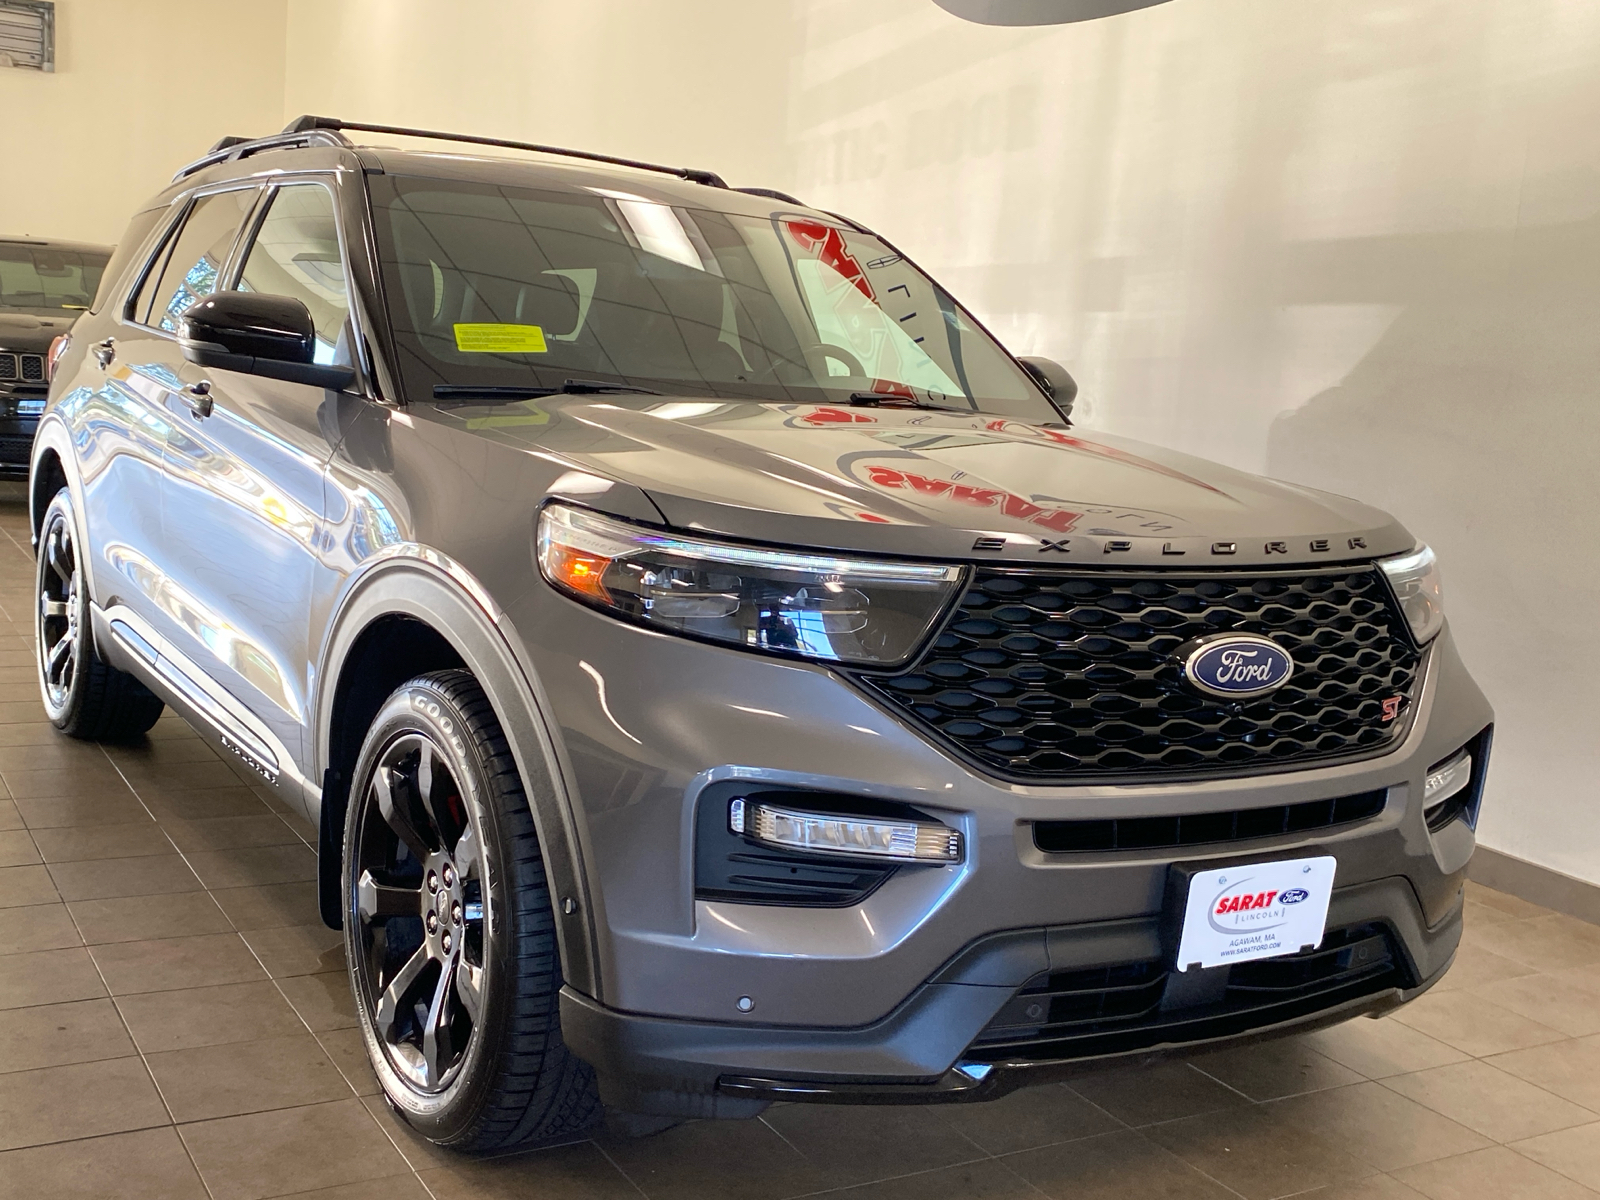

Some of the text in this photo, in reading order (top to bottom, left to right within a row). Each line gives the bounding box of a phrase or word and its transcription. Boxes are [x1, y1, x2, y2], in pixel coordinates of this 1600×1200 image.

[971, 536, 1368, 555] EXPLORER
[1215, 650, 1273, 683] Ford
[1382, 696, 1402, 721] ST
[1215, 889, 1306, 915] SARAT Ford
[1241, 911, 1280, 922] LINCOLN
[1220, 942, 1281, 956] WWW.SARATFORD.COM
[1229, 933, 1276, 948] AGAWAM, MA
